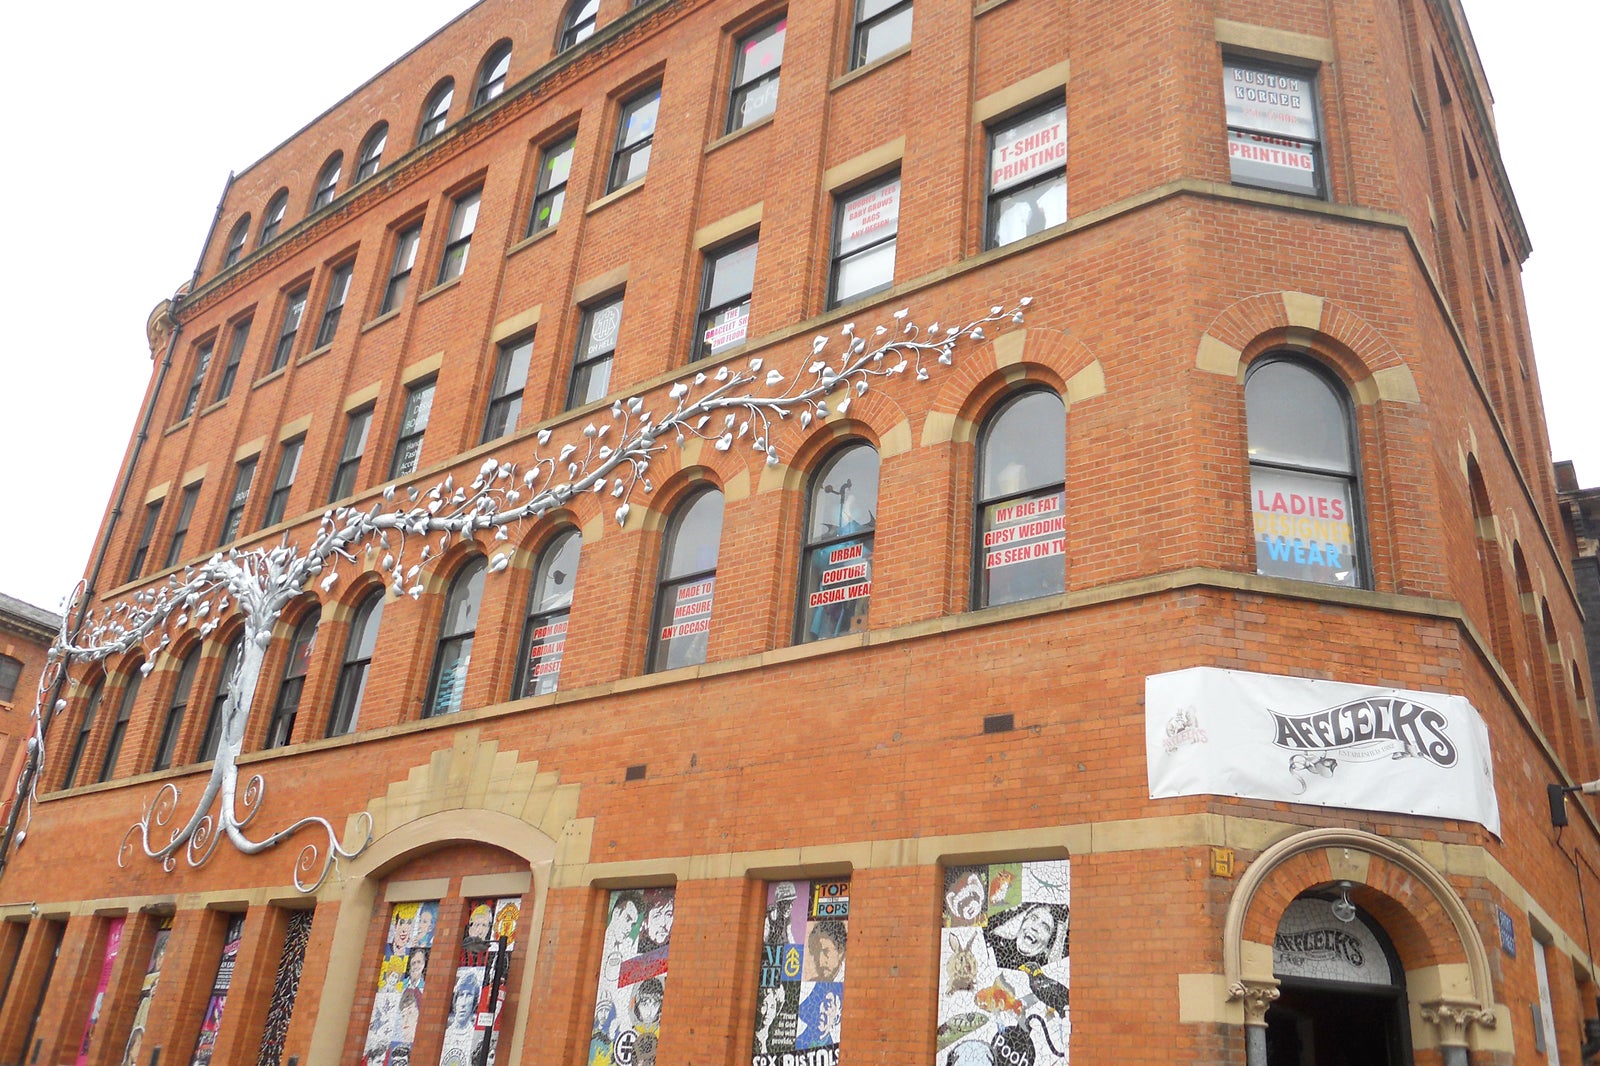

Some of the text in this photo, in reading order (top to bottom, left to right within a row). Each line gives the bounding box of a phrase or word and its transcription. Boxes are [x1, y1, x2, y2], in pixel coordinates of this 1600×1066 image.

[1234, 69, 1299, 91] KUSTOM
[1235, 86, 1300, 108] KORNER
[1000, 124, 1060, 162] T-SHIRT
[993, 141, 1066, 185] PRINTING
[1229, 142, 1311, 170] PRINTING
[727, 309, 738, 320] THE
[706, 322, 735, 339] BRACELET
[726, 329, 745, 341] FLOOR
[997, 496, 1058, 522] MY BIG FAT
[1258, 490, 1344, 520] LADIES
[985, 528, 1015, 546] GIPSY
[1254, 511, 1353, 545] DESIGNER
[831, 545, 862, 562] URBAN
[987, 538, 1066, 567] AS SEEN ON TV
[1264, 535, 1342, 569] WEAR
[823, 564, 866, 584] COUTURE
[679, 582, 712, 599] MADE TO
[810, 588, 845, 606] CASUAL
[675, 600, 711, 618] MEASURE
[534, 626, 553, 640] PROM
[662, 627, 677, 639] ANY
[531, 643, 555, 657] BRIDAL
[1276, 698, 1455, 766] AFFLECKS
[820, 883, 848, 896] TOP
[818, 903, 848, 915] POPS
